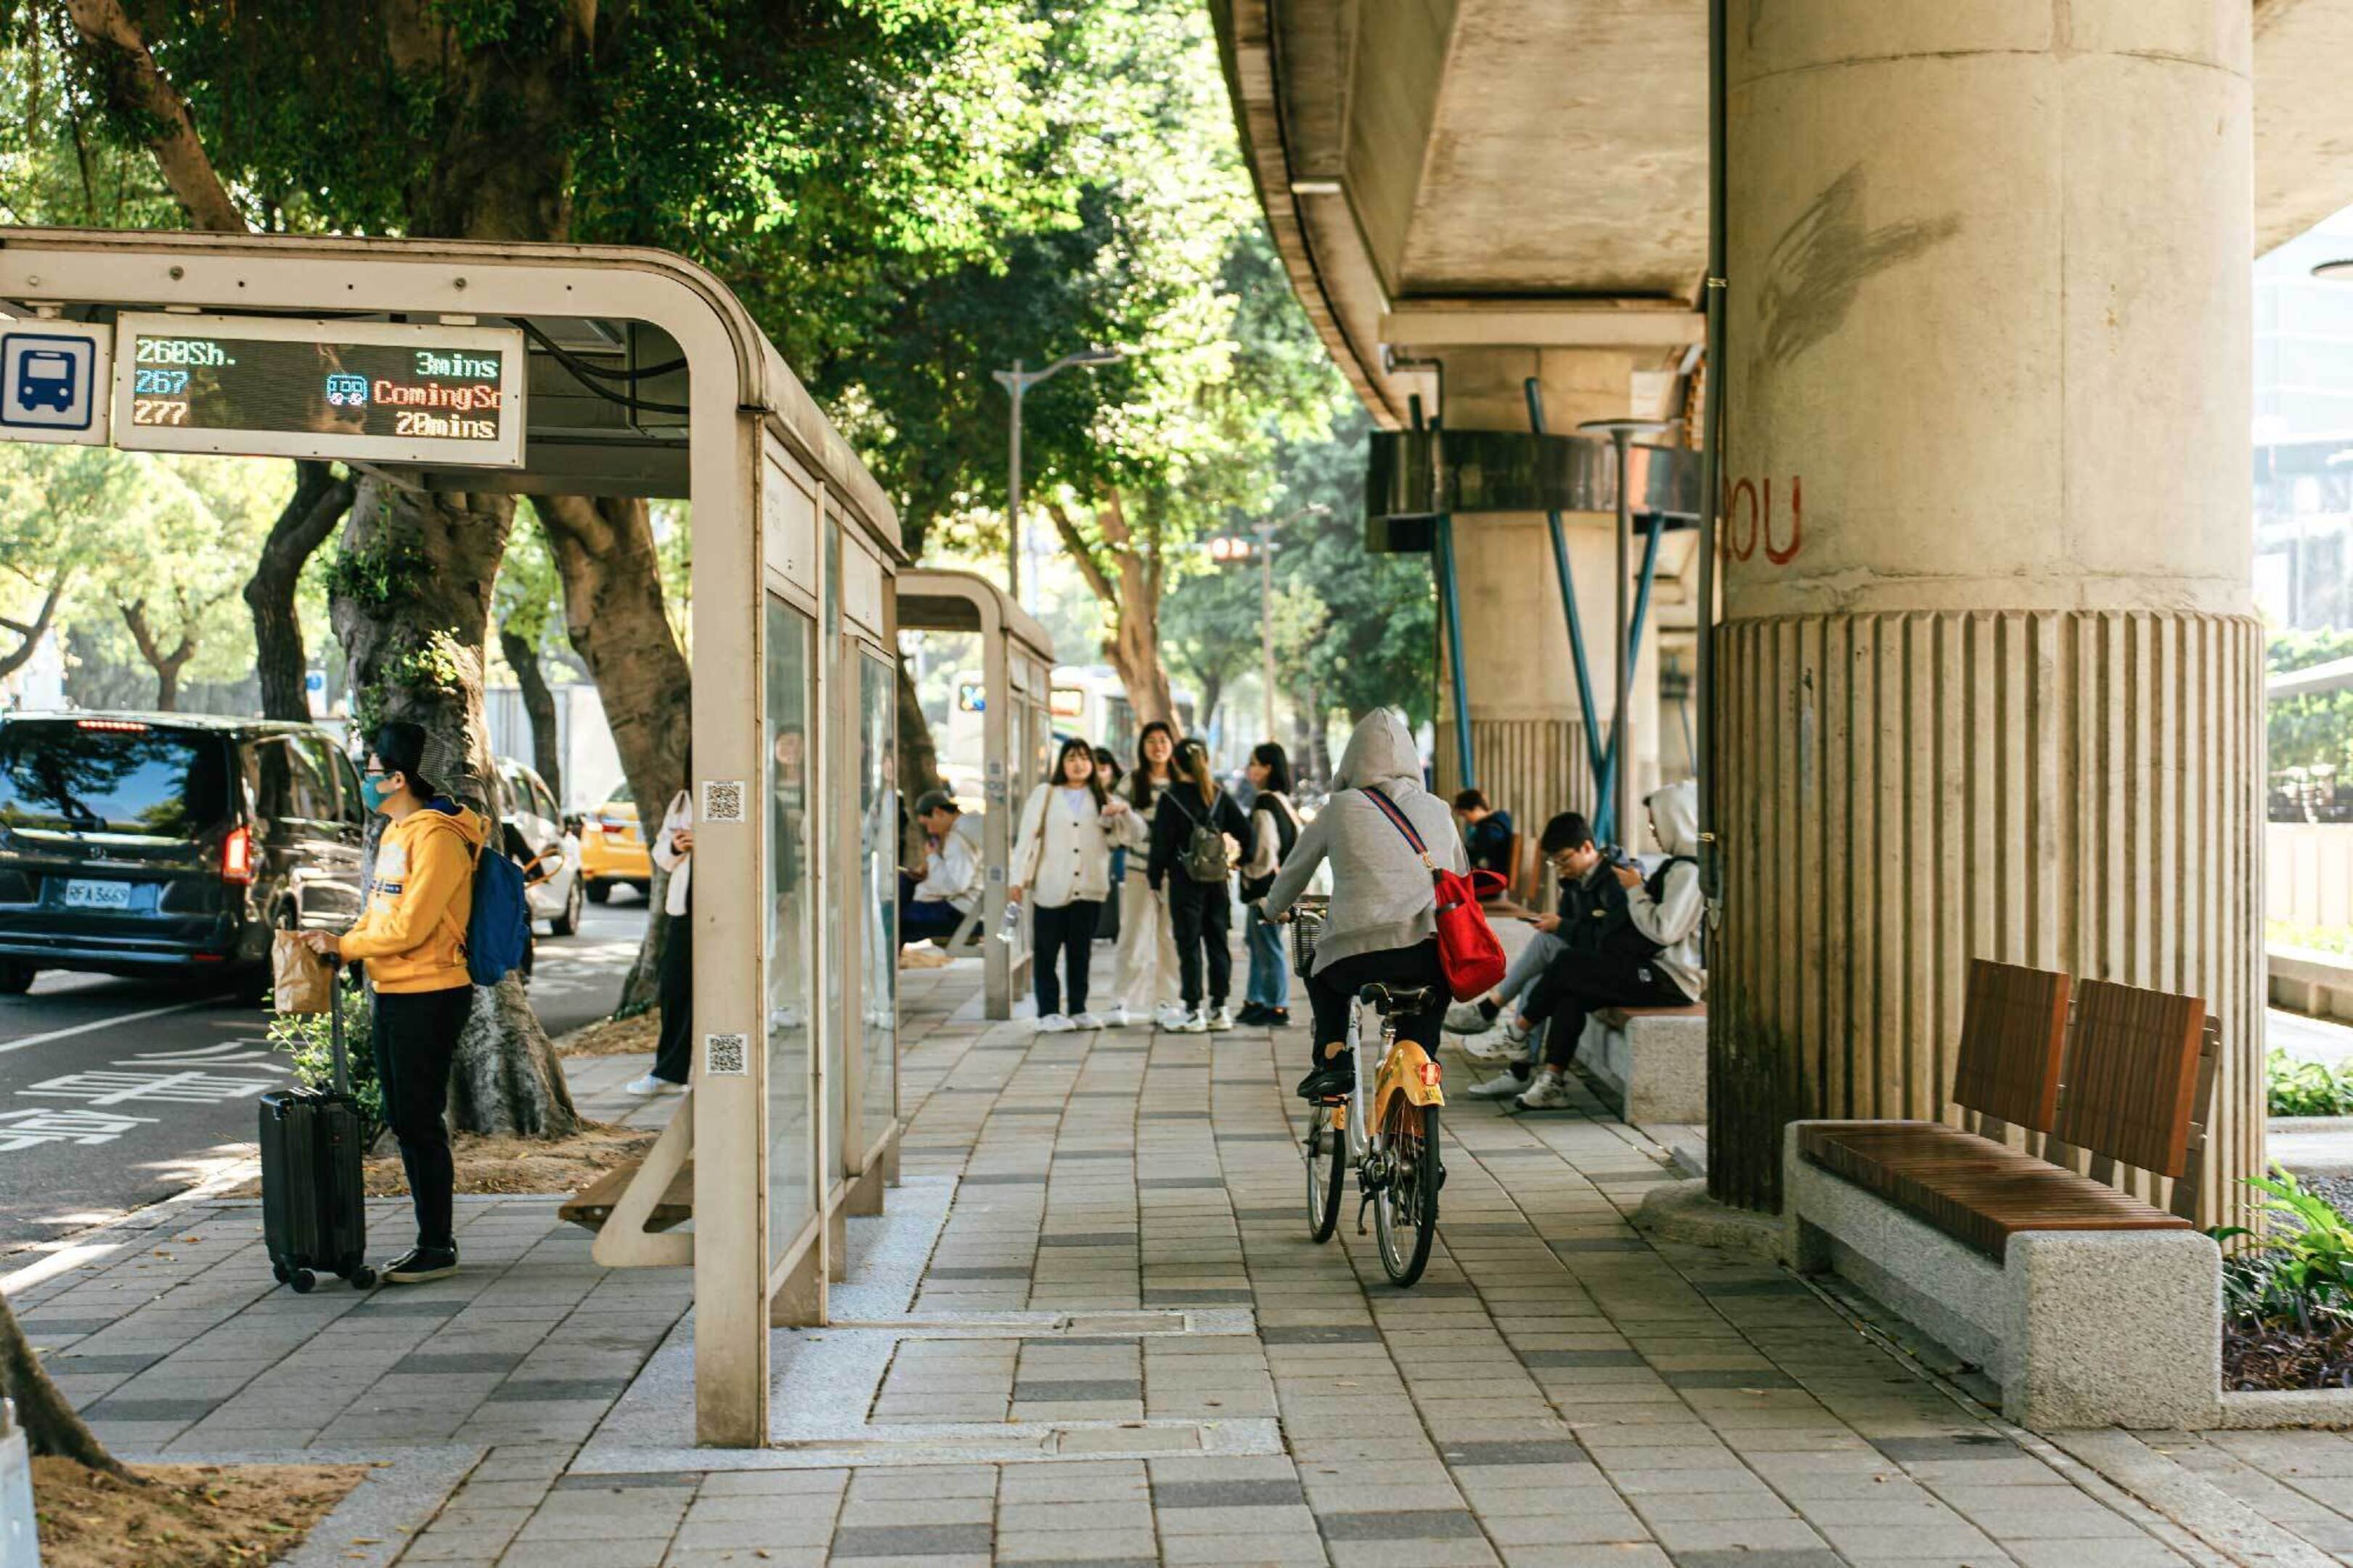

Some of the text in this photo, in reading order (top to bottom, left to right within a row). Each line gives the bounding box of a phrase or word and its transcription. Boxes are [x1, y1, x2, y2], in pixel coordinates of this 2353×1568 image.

[136, 339, 499, 378] 260Sh. 3mins
[135, 369, 189, 394] 267
[134, 399, 496, 438] 277 20mins
